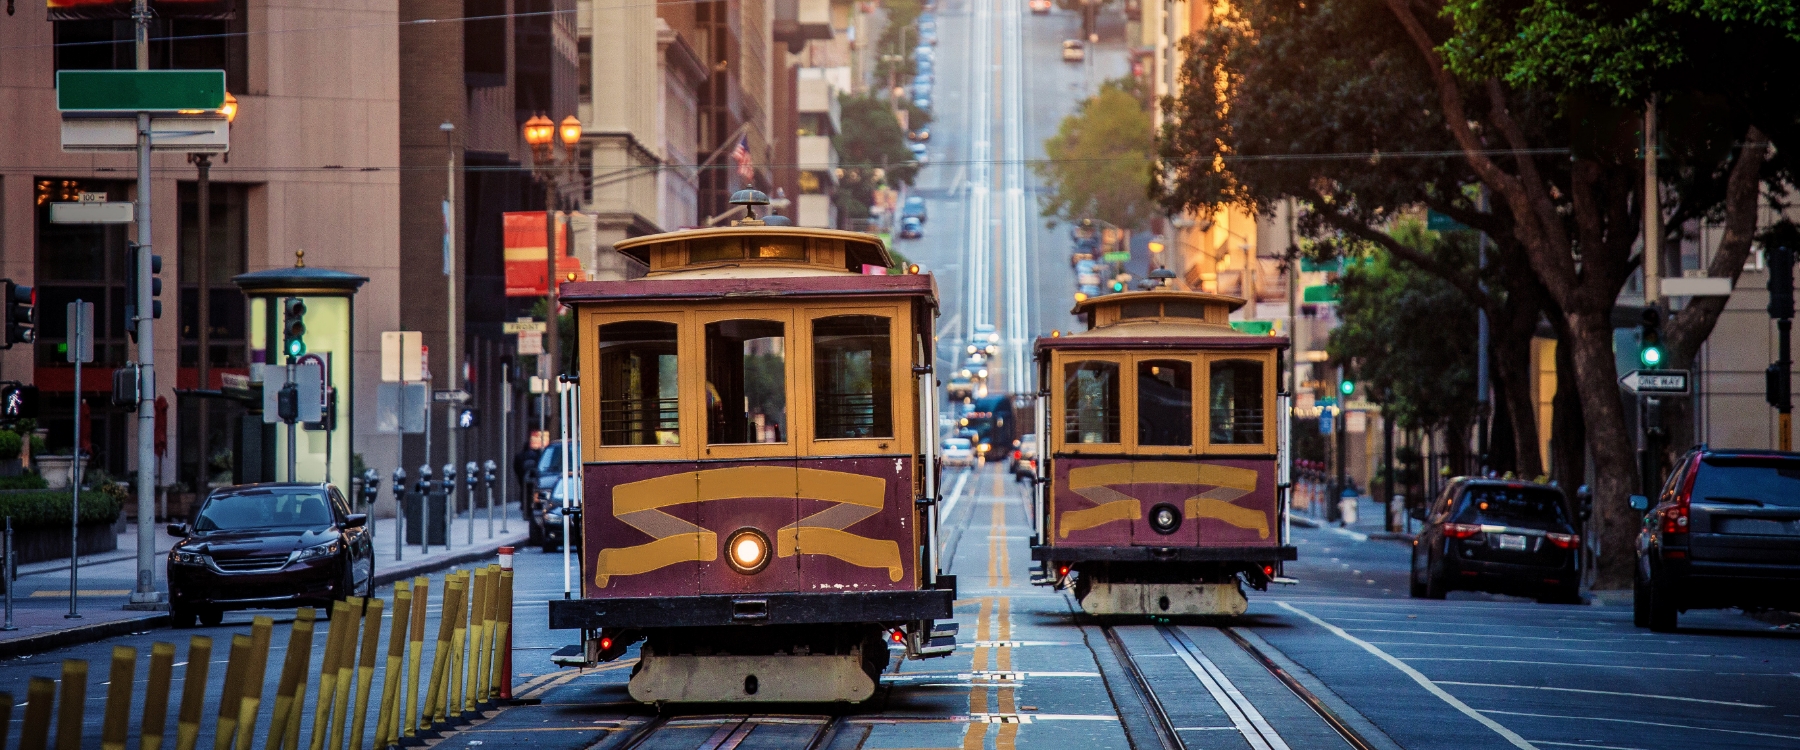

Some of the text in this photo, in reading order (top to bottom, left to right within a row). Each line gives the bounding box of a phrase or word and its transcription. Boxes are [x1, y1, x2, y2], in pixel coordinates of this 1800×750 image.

[83, 193, 95, 201] 100
[1639, 375, 1681, 386] ONE WAY
